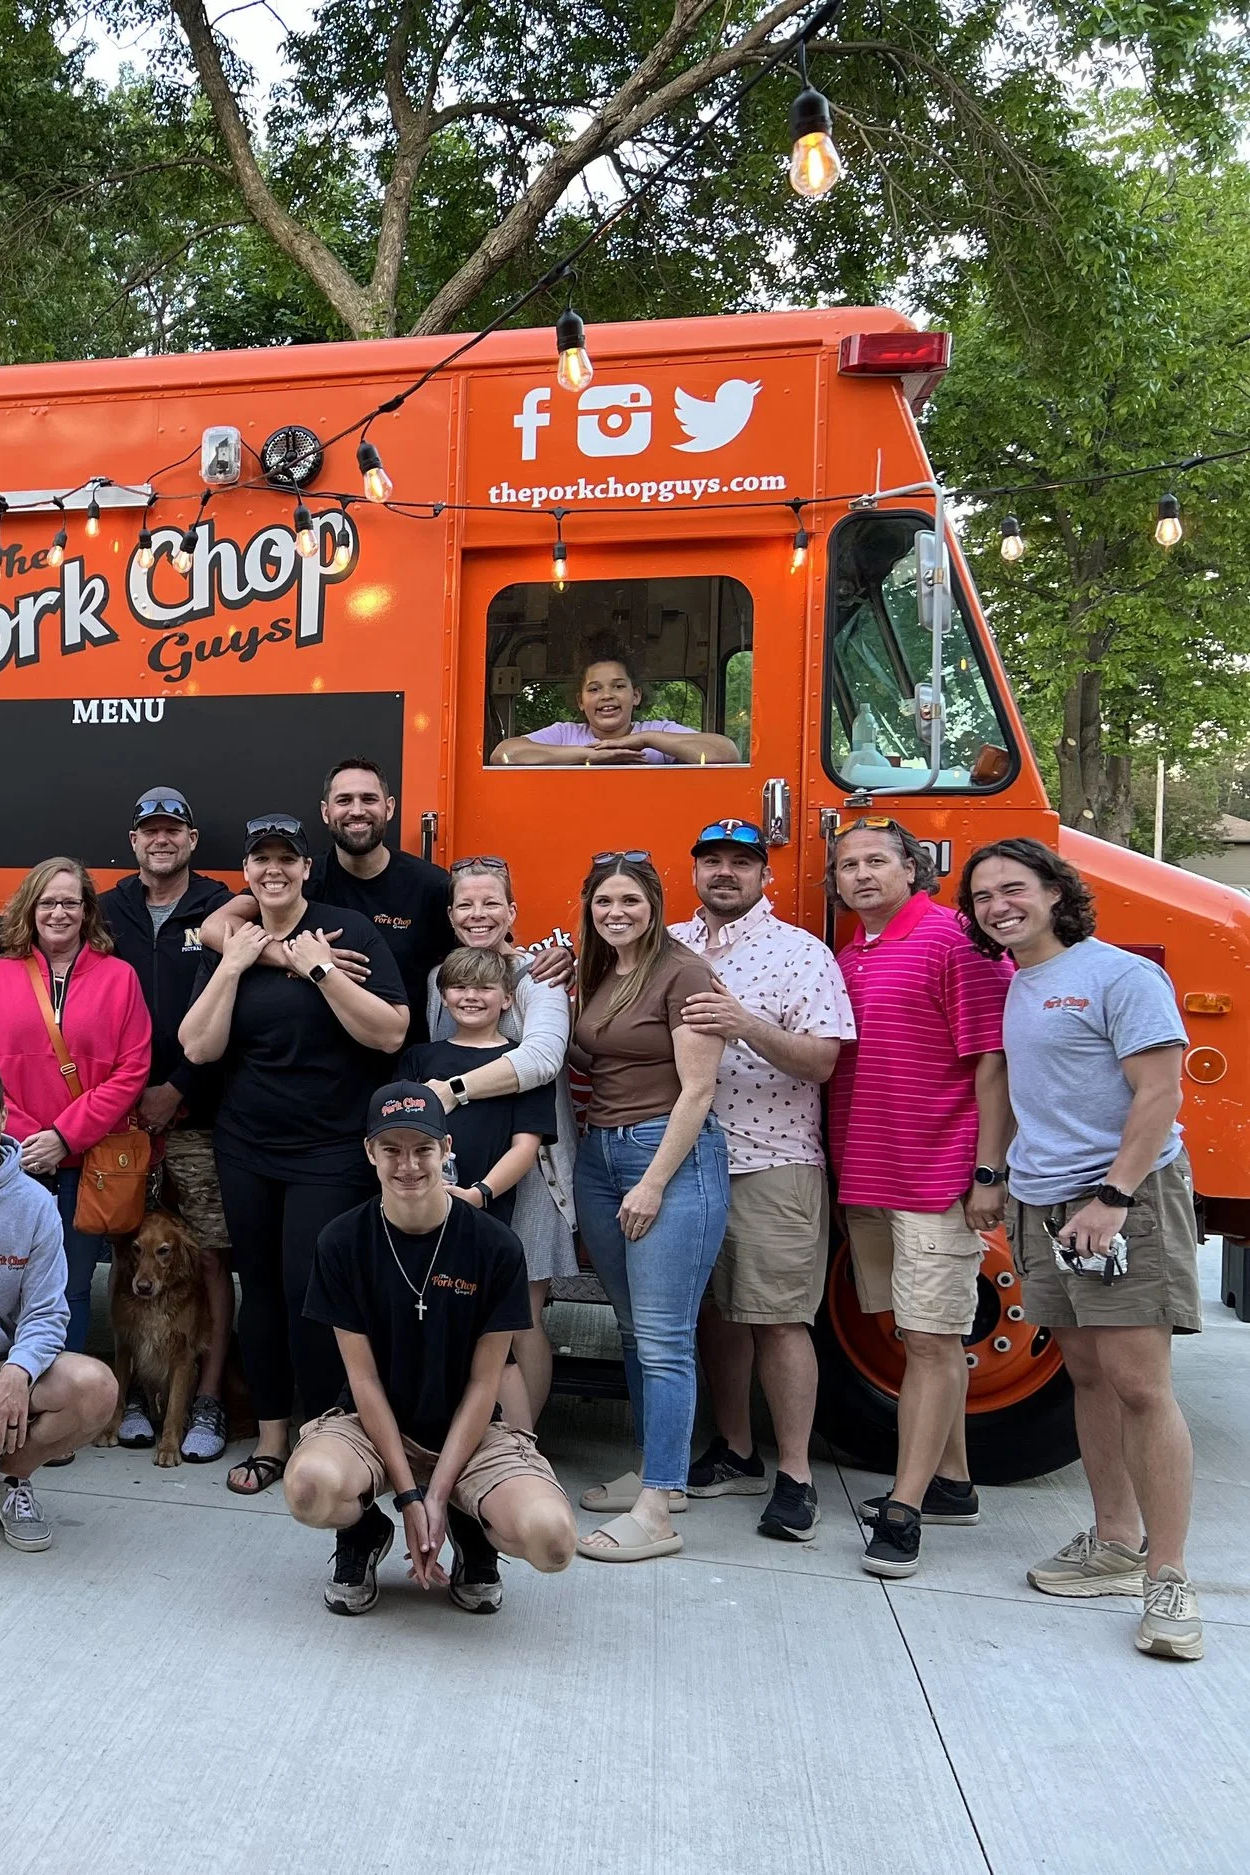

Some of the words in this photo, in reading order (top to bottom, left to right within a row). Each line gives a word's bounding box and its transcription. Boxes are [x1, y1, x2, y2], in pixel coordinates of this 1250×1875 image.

[488, 474, 787, 508] theporkchopguys.com
[127, 508, 359, 649] Chop
[148, 617, 293, 683] Guys
[72, 697, 166, 724] MENU
[184, 927, 203, 947] N
[515, 927, 574, 952] ork
[454, 1278, 477, 1296] Chop
